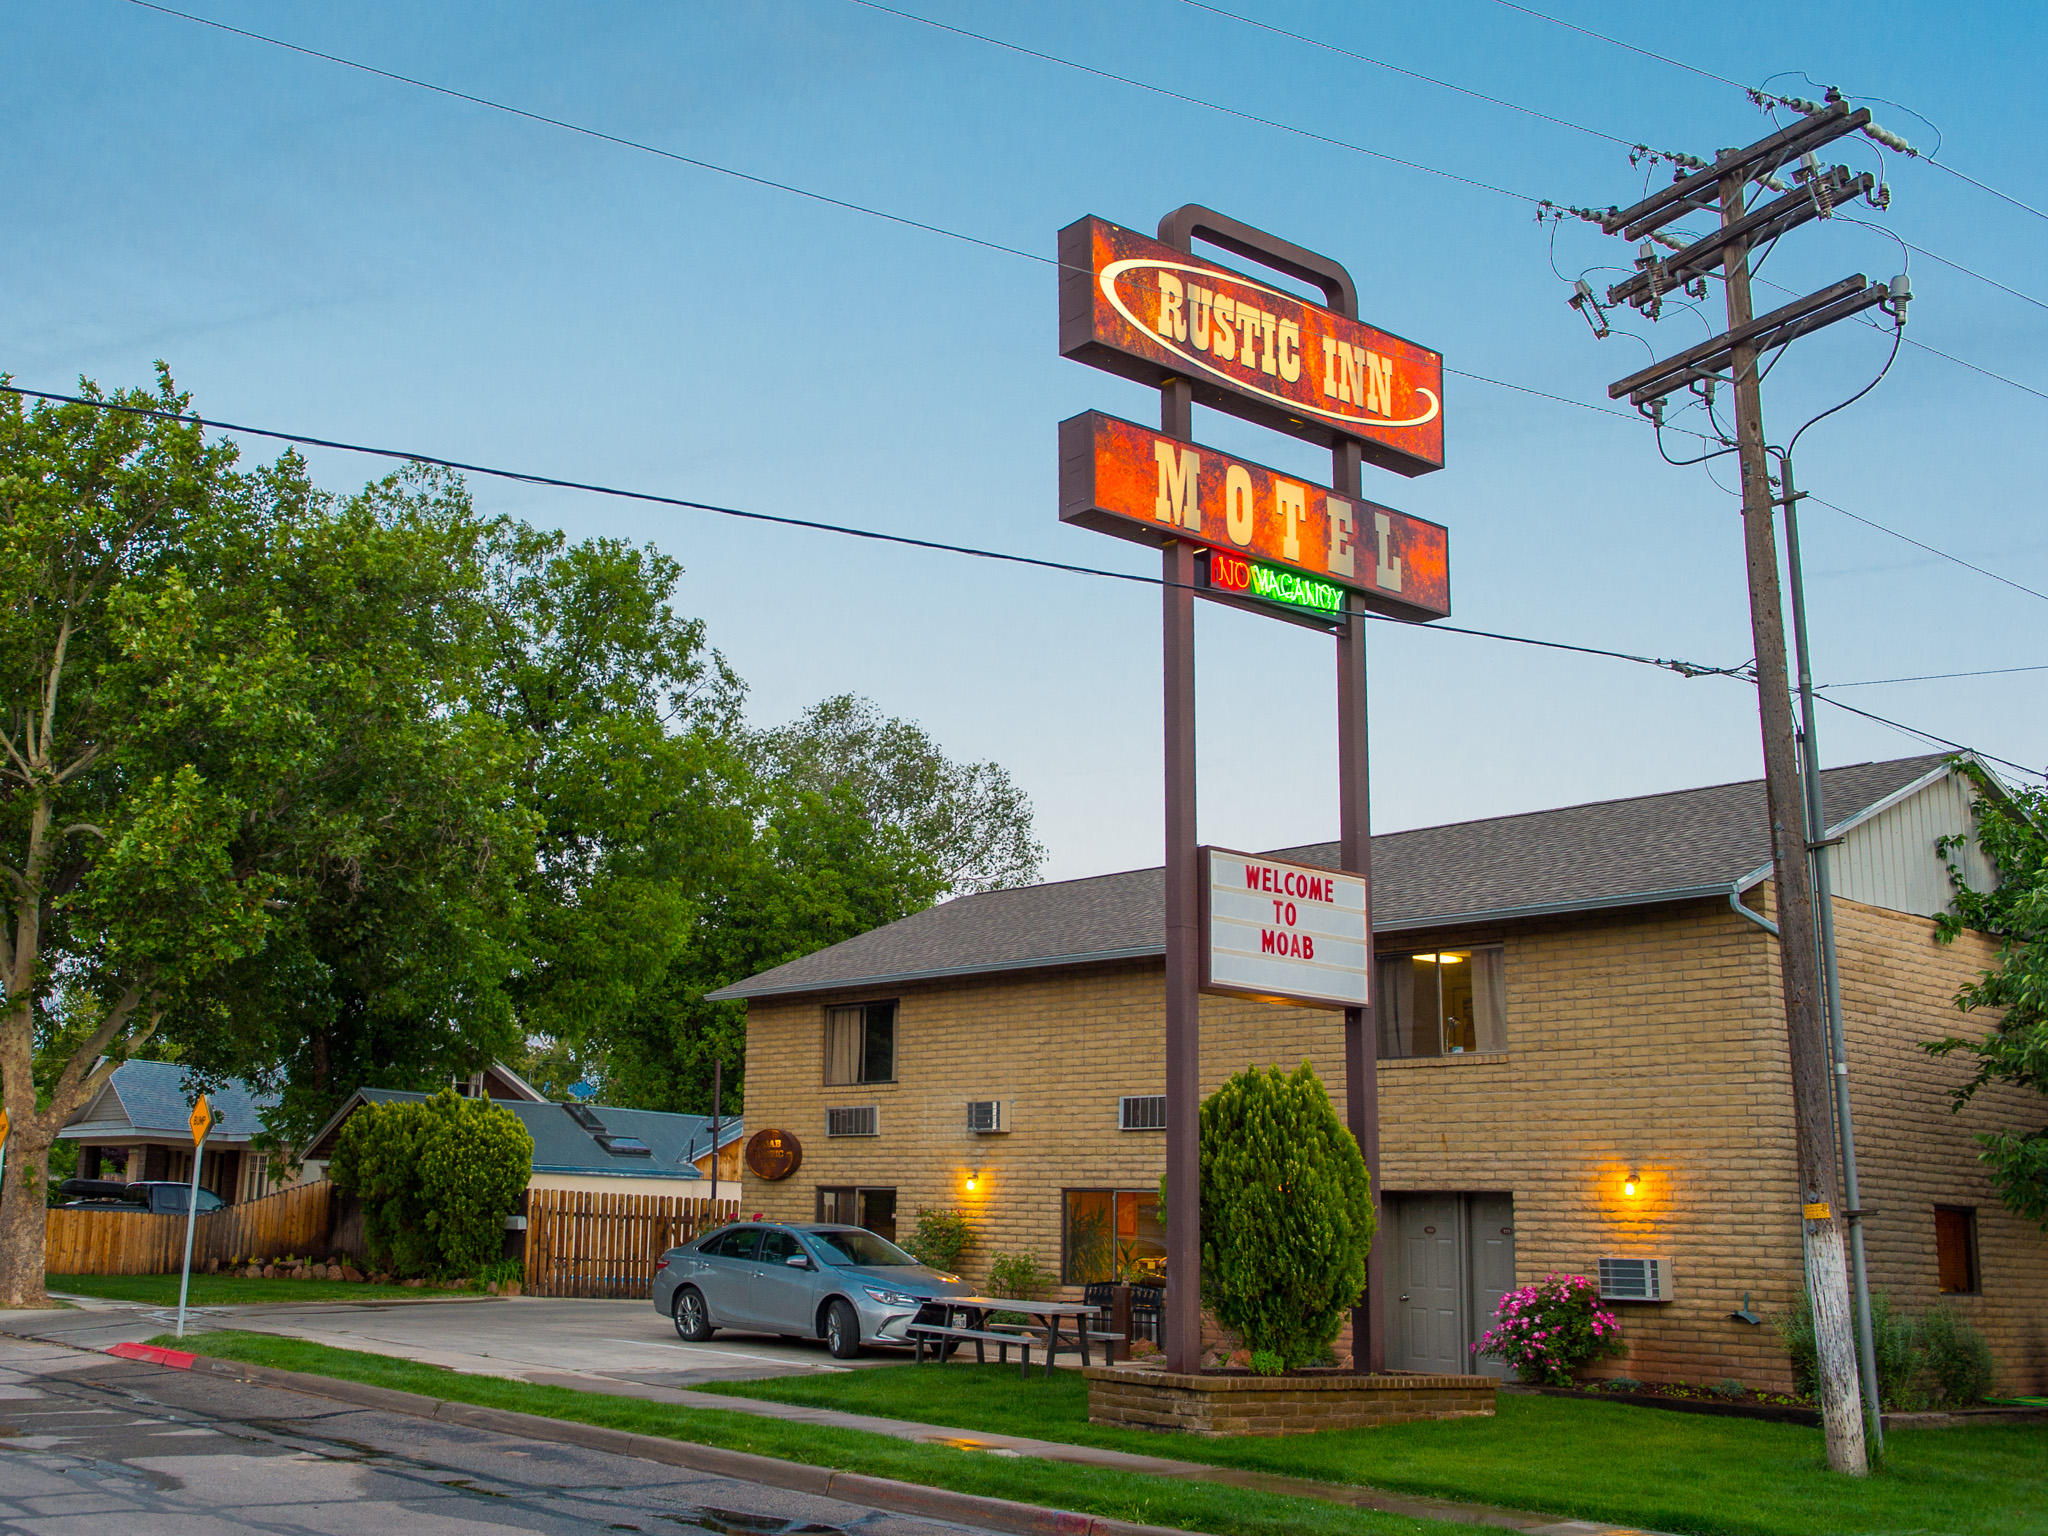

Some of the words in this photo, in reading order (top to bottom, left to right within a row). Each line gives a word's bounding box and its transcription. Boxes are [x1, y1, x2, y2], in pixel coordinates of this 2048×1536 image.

[1157, 270, 1301, 384] RUSTIC
[1322, 334, 1394, 418] INN
[1154, 440, 1402, 593] MOTEL
[1216, 556, 1251, 589] NO
[1251, 565, 1343, 612] VACANCY
[1245, 864, 1334, 903] WELCOME
[1272, 900, 1297, 926] TO
[1261, 928, 1314, 959] MOAB
[193, 1115, 206, 1126] BUMP
